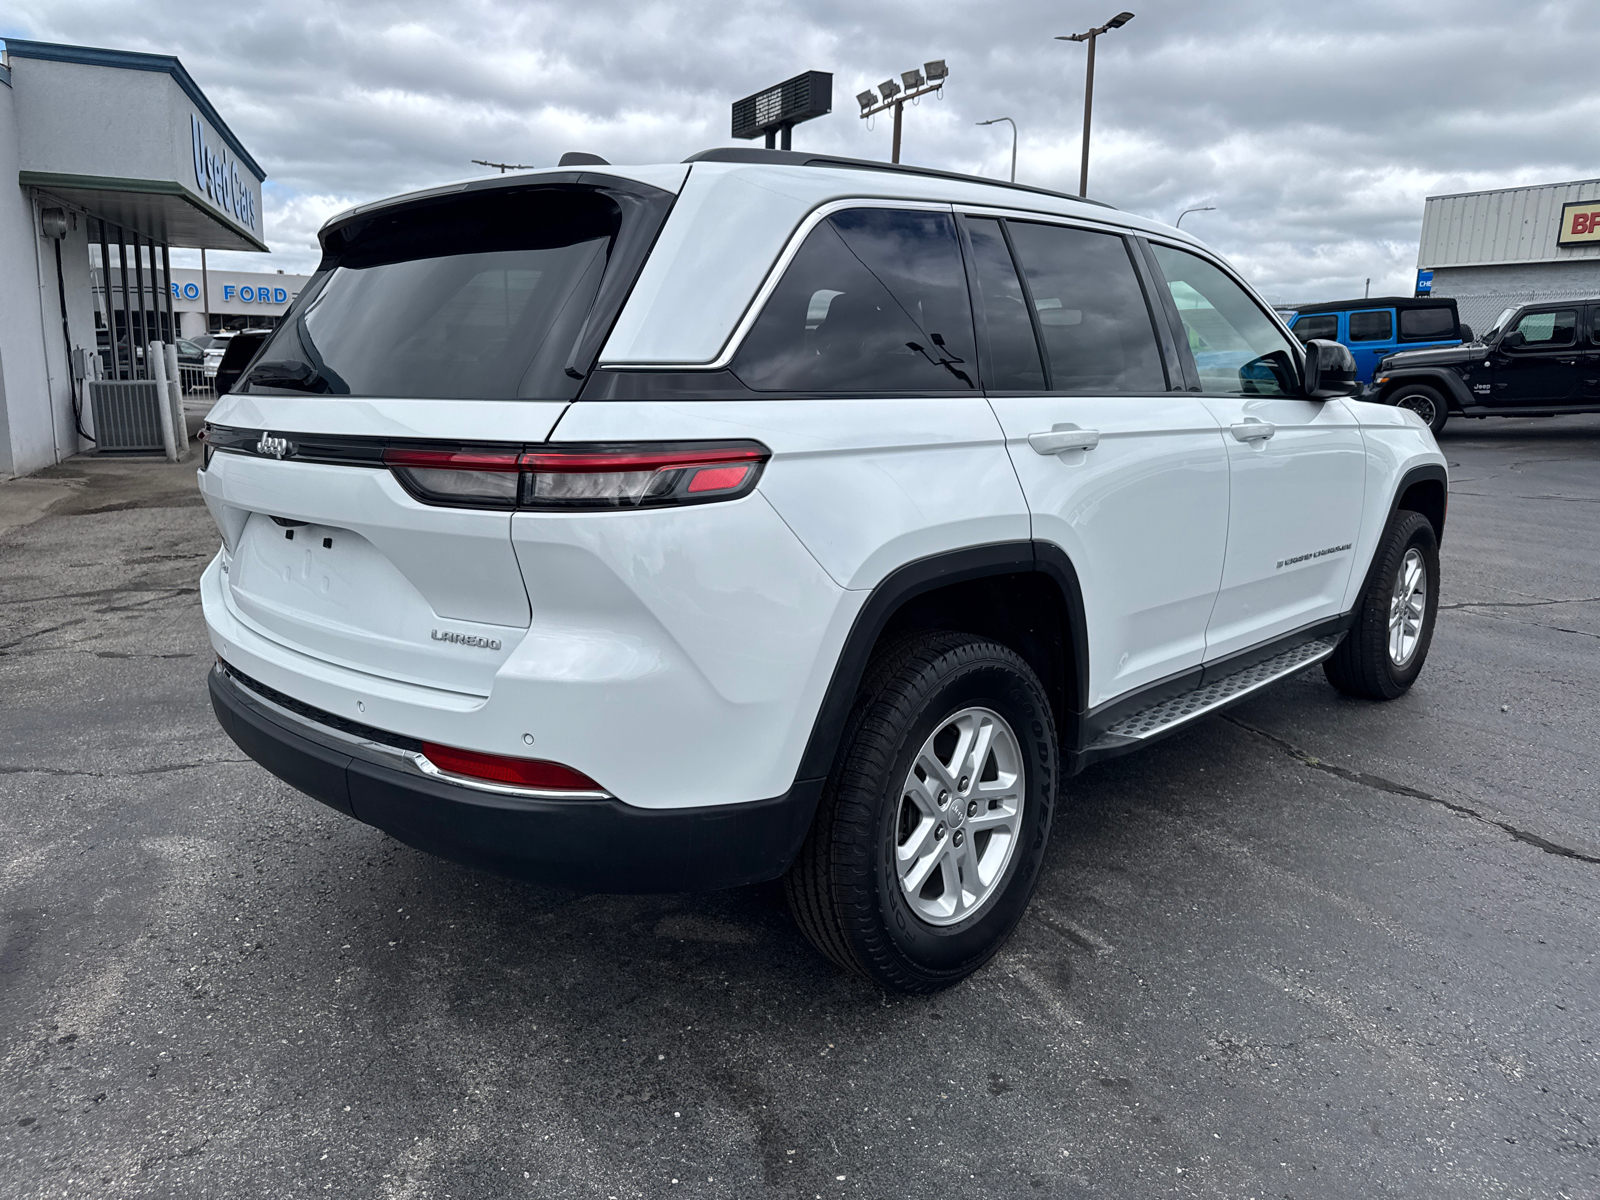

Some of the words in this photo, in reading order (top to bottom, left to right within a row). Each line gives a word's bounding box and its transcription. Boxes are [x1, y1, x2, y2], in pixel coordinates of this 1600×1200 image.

[190, 112, 231, 212] Used
[230, 160, 256, 231] Cars
[223, 285, 288, 304] FORD
[256, 431, 287, 460] Jeep
[431, 628, 502, 651] LAREDO
[1009, 686, 1053, 883] GOODYEAR
